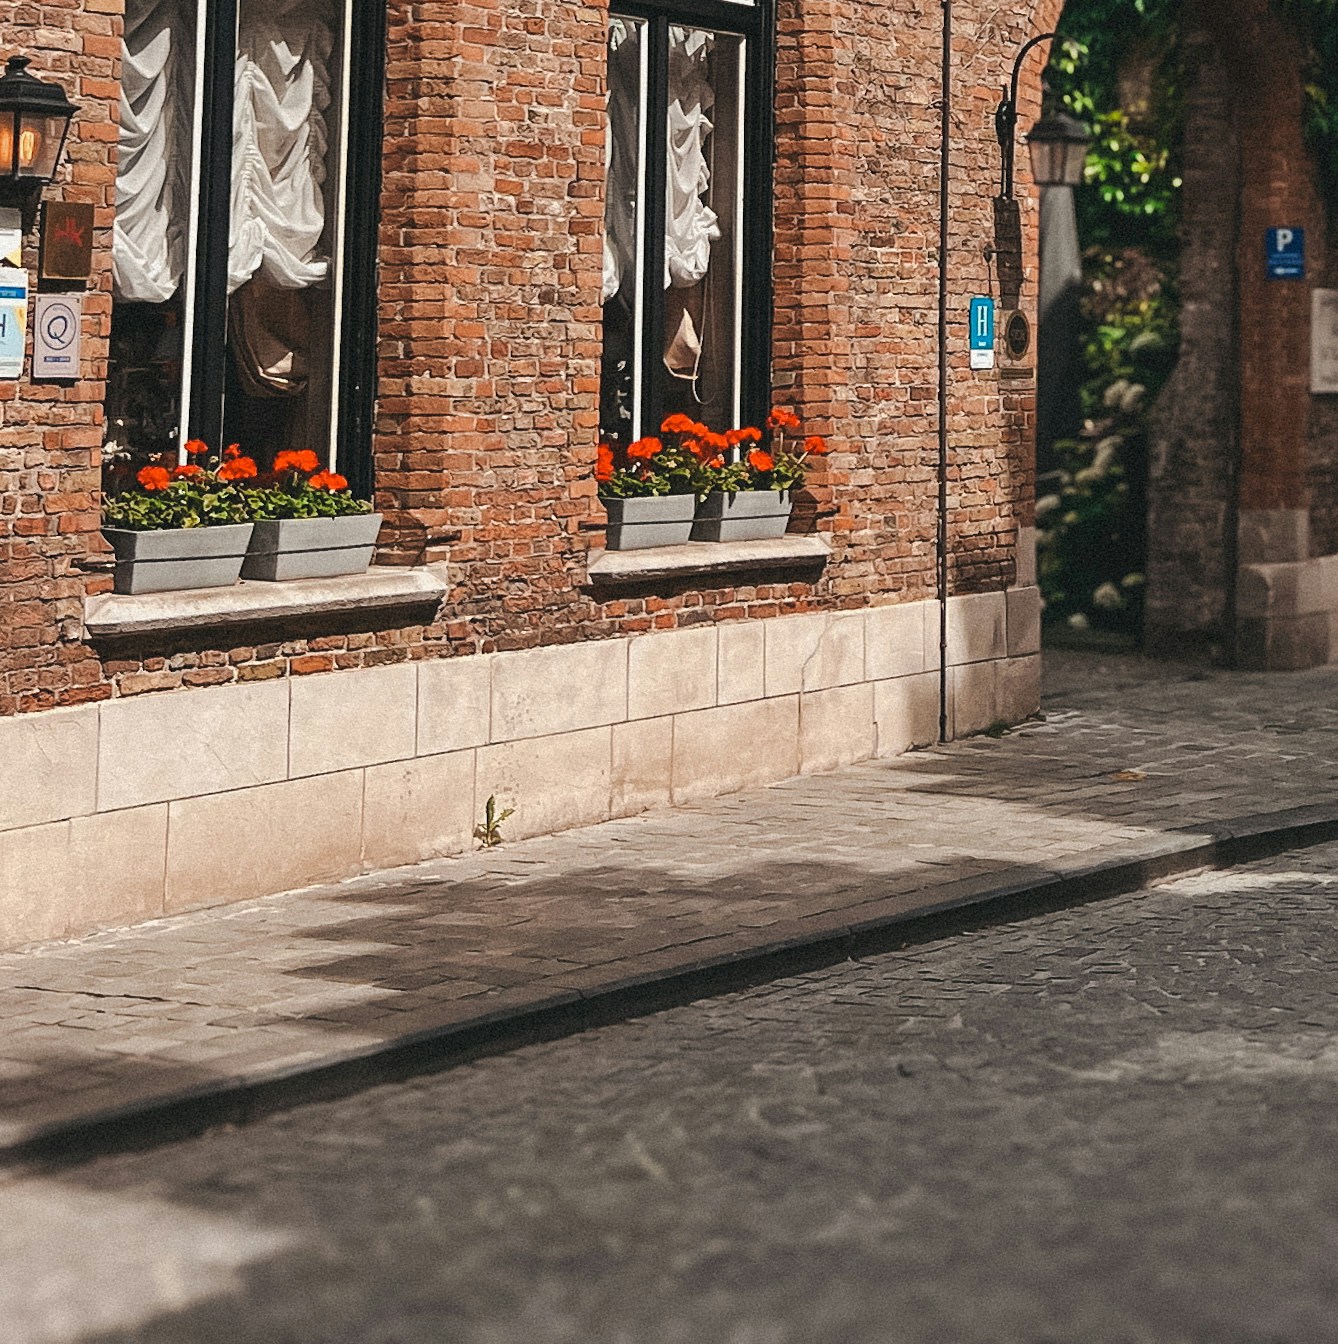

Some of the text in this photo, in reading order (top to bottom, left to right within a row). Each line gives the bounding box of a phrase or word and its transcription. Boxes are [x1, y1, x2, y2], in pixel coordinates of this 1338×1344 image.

[1276, 228, 1294, 252] P
[47, 315, 67, 344] Q
[977, 305, 988, 337] H
